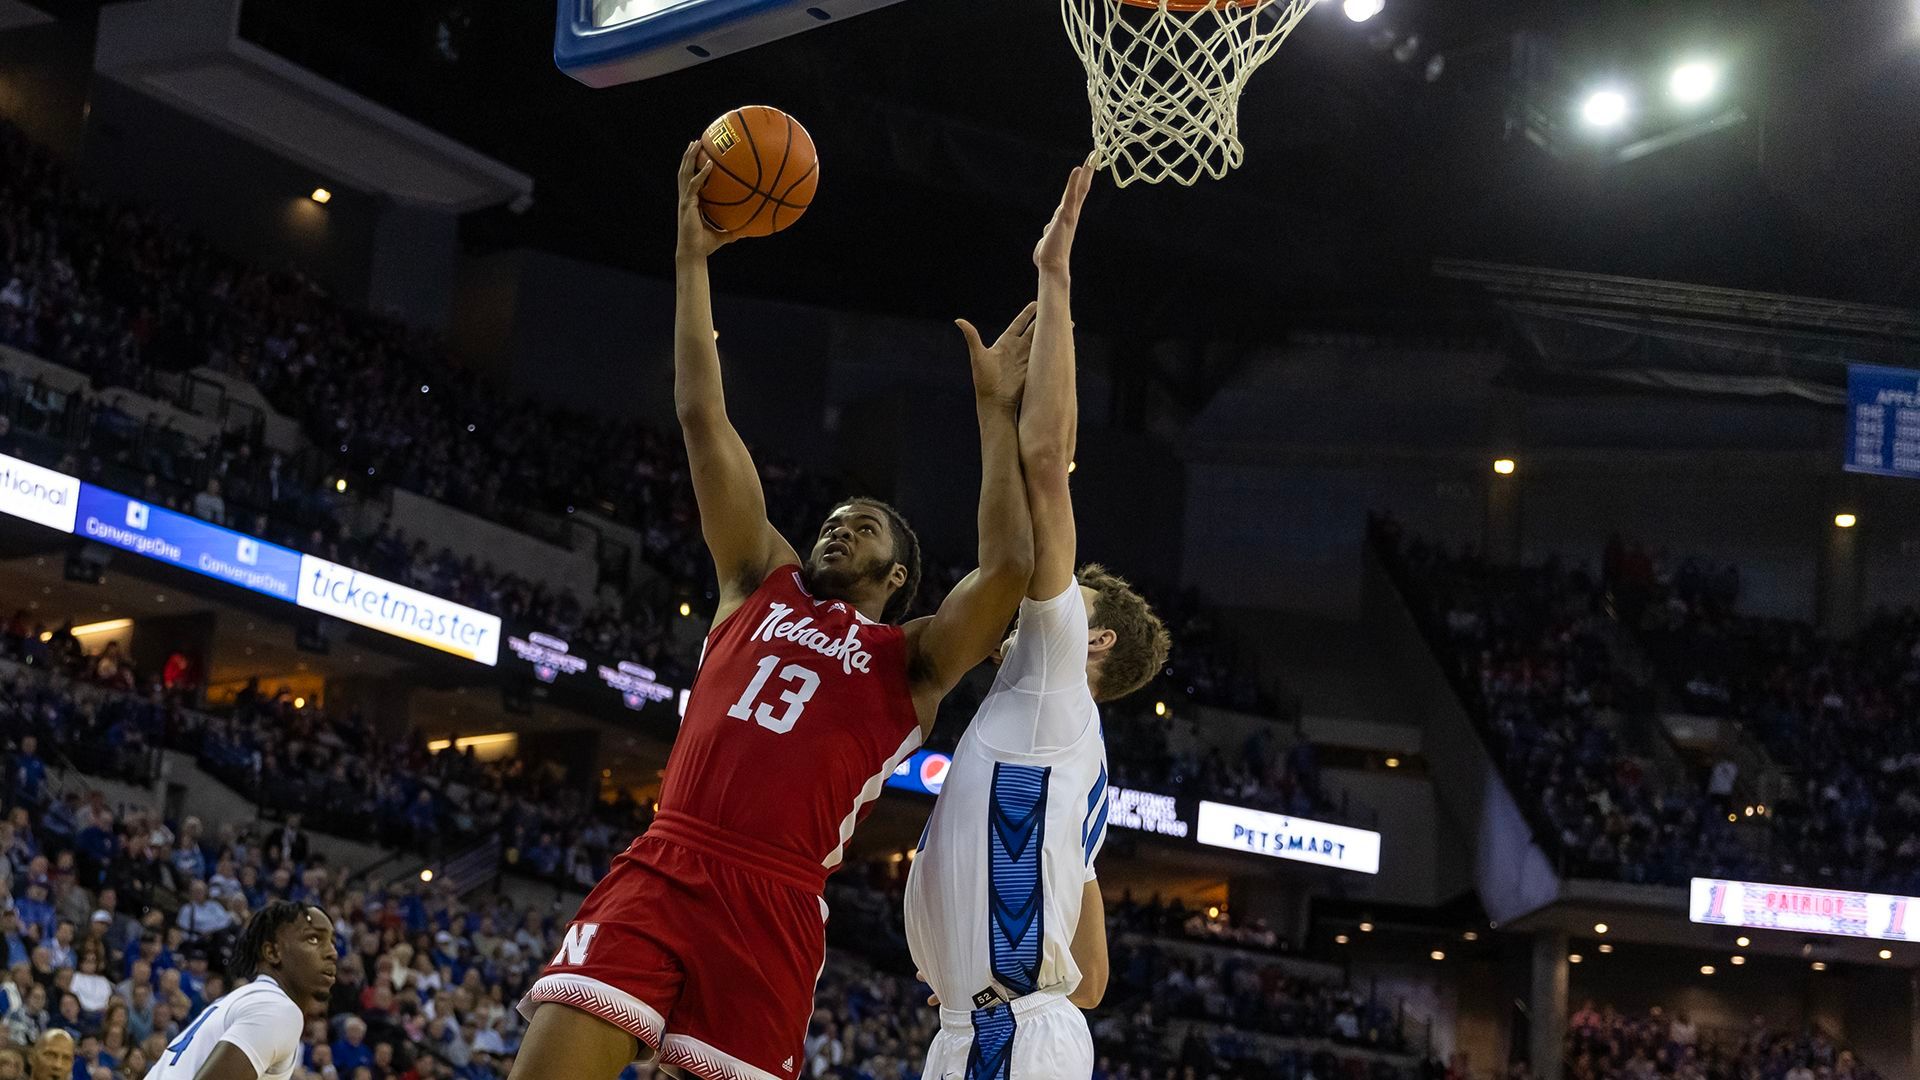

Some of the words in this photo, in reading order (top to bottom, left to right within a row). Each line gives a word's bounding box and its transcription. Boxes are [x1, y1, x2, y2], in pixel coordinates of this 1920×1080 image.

[0, 467, 69, 506] tional
[86, 516, 182, 561] ConvergeOne
[199, 553, 288, 594] ConvergeOne
[312, 568, 489, 648] ticketmaster
[750, 602, 873, 675] Nebraska
[727, 654, 821, 735] 13
[551, 922, 600, 967] N
[977, 992, 993, 1005] 52
